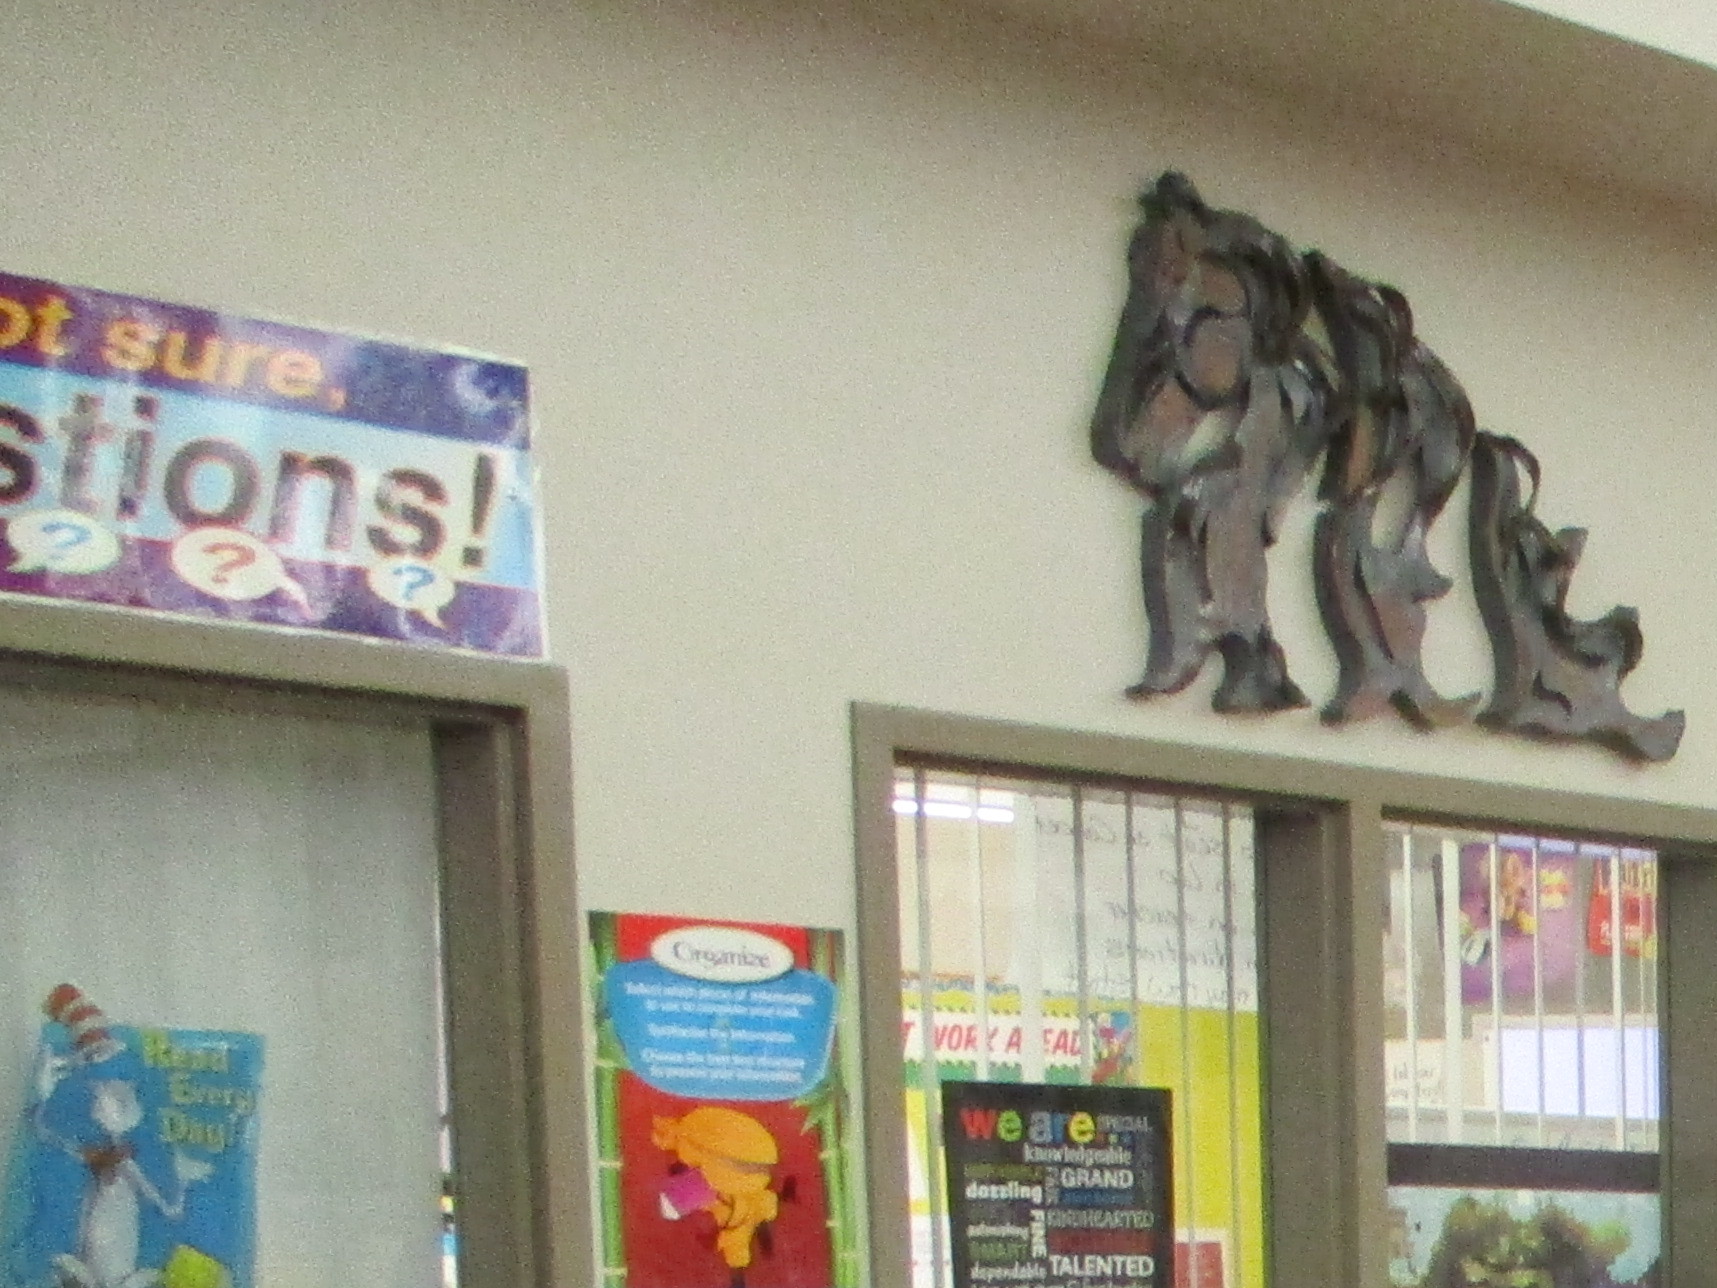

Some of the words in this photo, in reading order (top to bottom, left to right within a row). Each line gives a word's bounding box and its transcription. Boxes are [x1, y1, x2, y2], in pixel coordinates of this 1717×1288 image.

[673, 940, 770, 971] Organize
[960, 1108, 1024, 1142] we
[1060, 1168, 1134, 1189] GRAND
[965, 1181, 1044, 1204] dazzling
[1049, 1254, 1154, 1277] TALENTED
